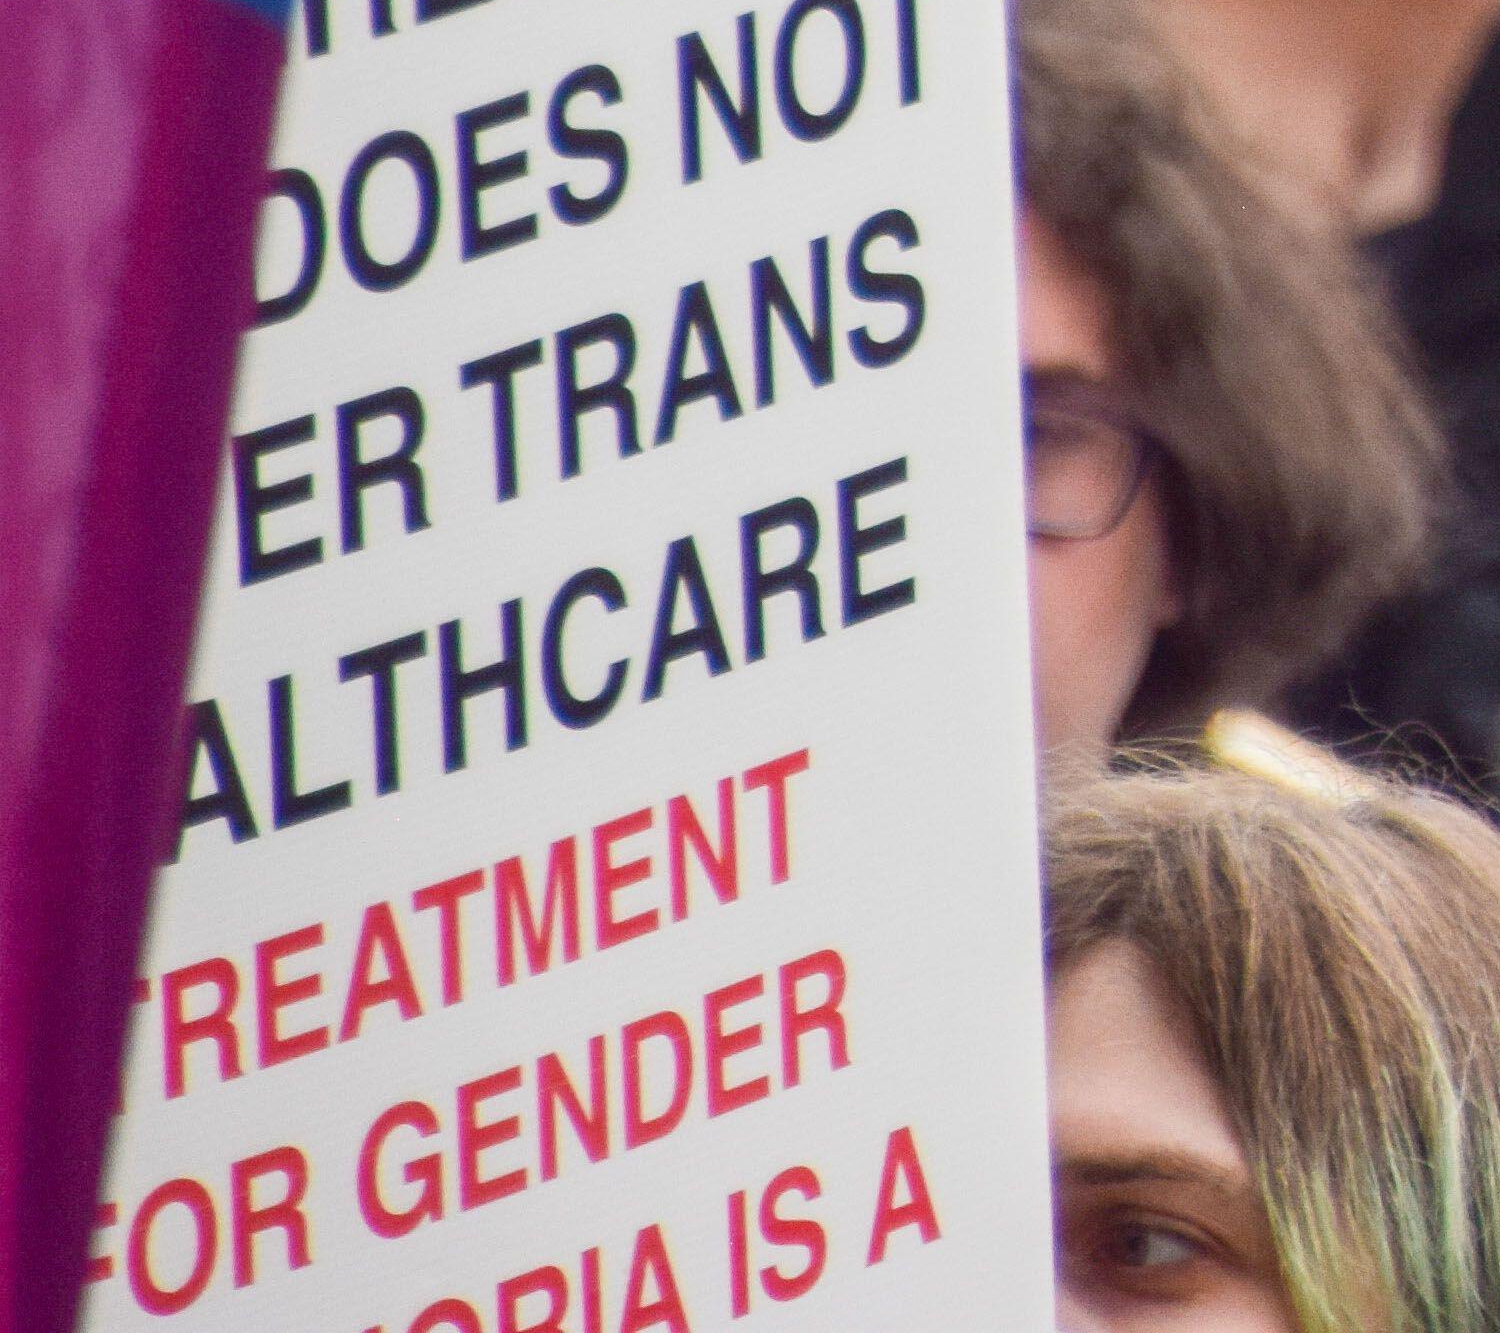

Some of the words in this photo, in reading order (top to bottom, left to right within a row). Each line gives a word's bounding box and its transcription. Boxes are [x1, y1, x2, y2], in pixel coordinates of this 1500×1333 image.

[232, 387, 431, 588] ER
[458, 207, 926, 504] TRANS
[130, 749, 808, 1100] REATMENT
[355, 948, 851, 1240] GENDER
[727, 1164, 827, 1319] IS
[866, 1125, 940, 1267] A
